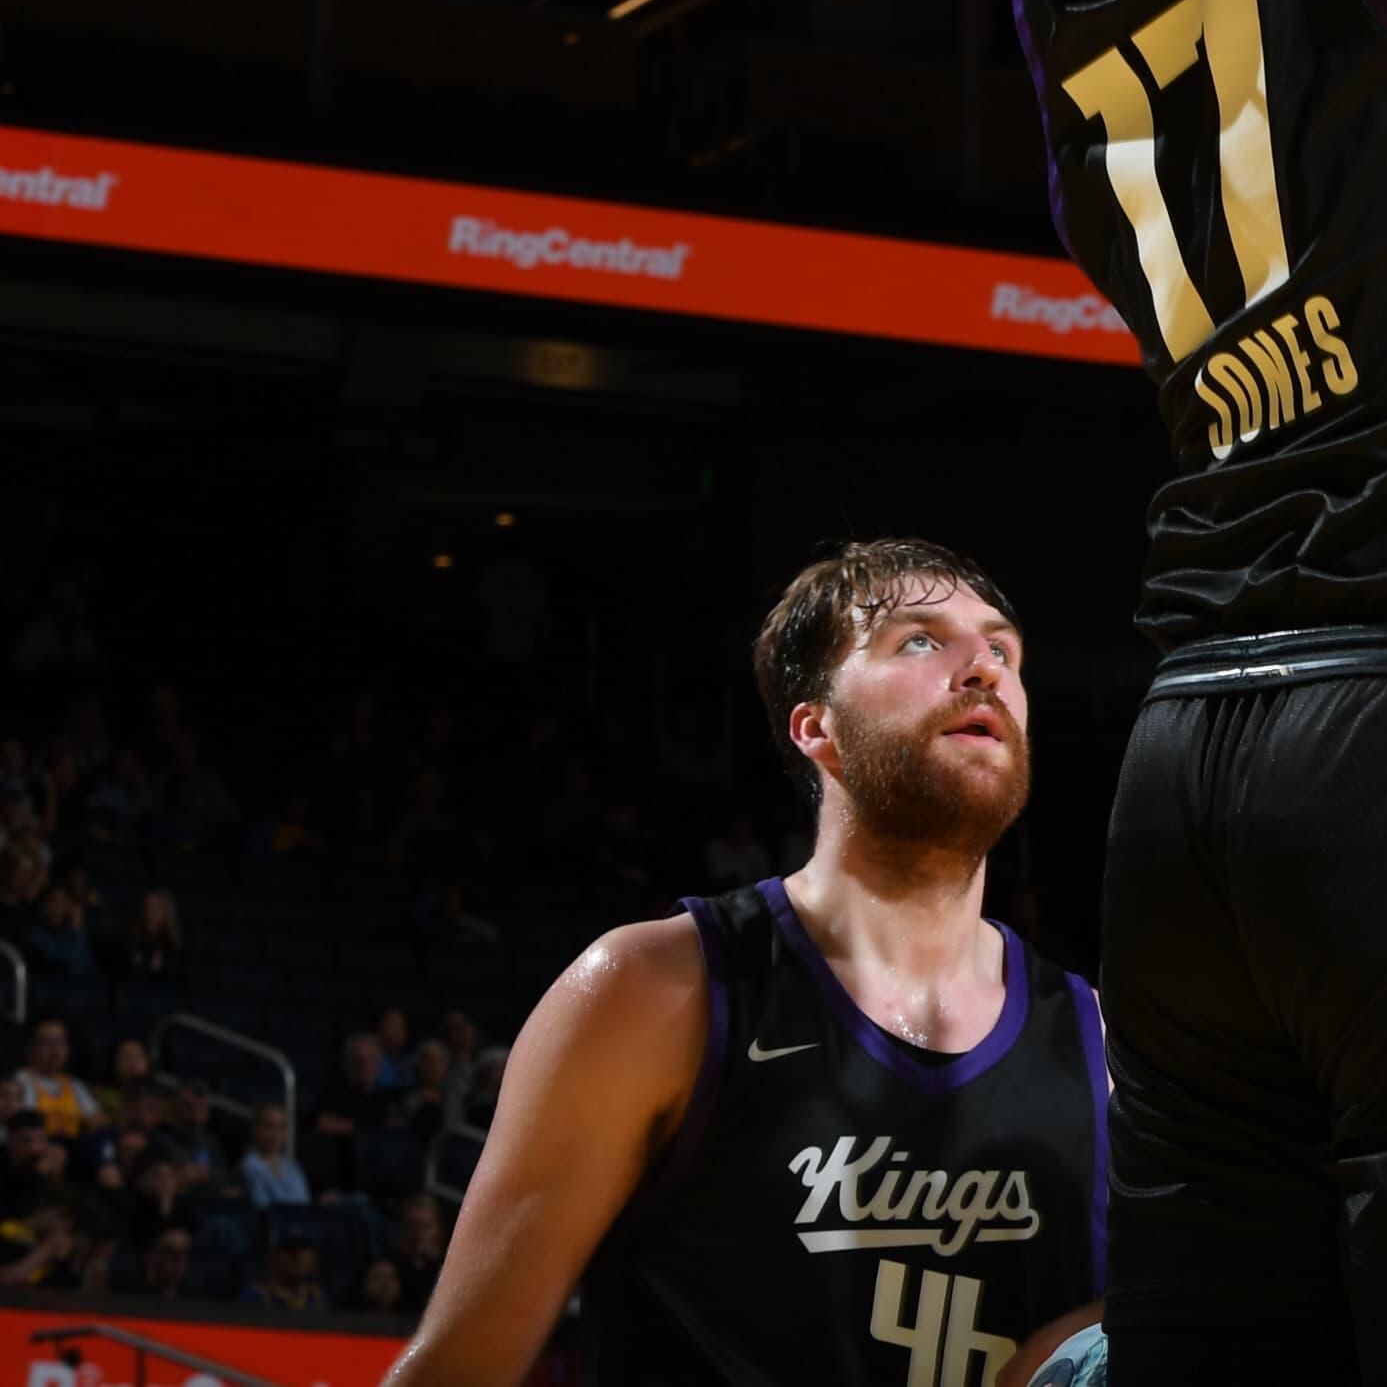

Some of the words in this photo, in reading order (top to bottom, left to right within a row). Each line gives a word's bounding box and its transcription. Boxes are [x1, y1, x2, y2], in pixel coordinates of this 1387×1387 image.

[449, 215, 689, 280] RingCentral
[991, 282, 1133, 334] RingCe
[1195, 295, 1359, 460] JONES
[787, 1135, 1041, 1257] Kings
